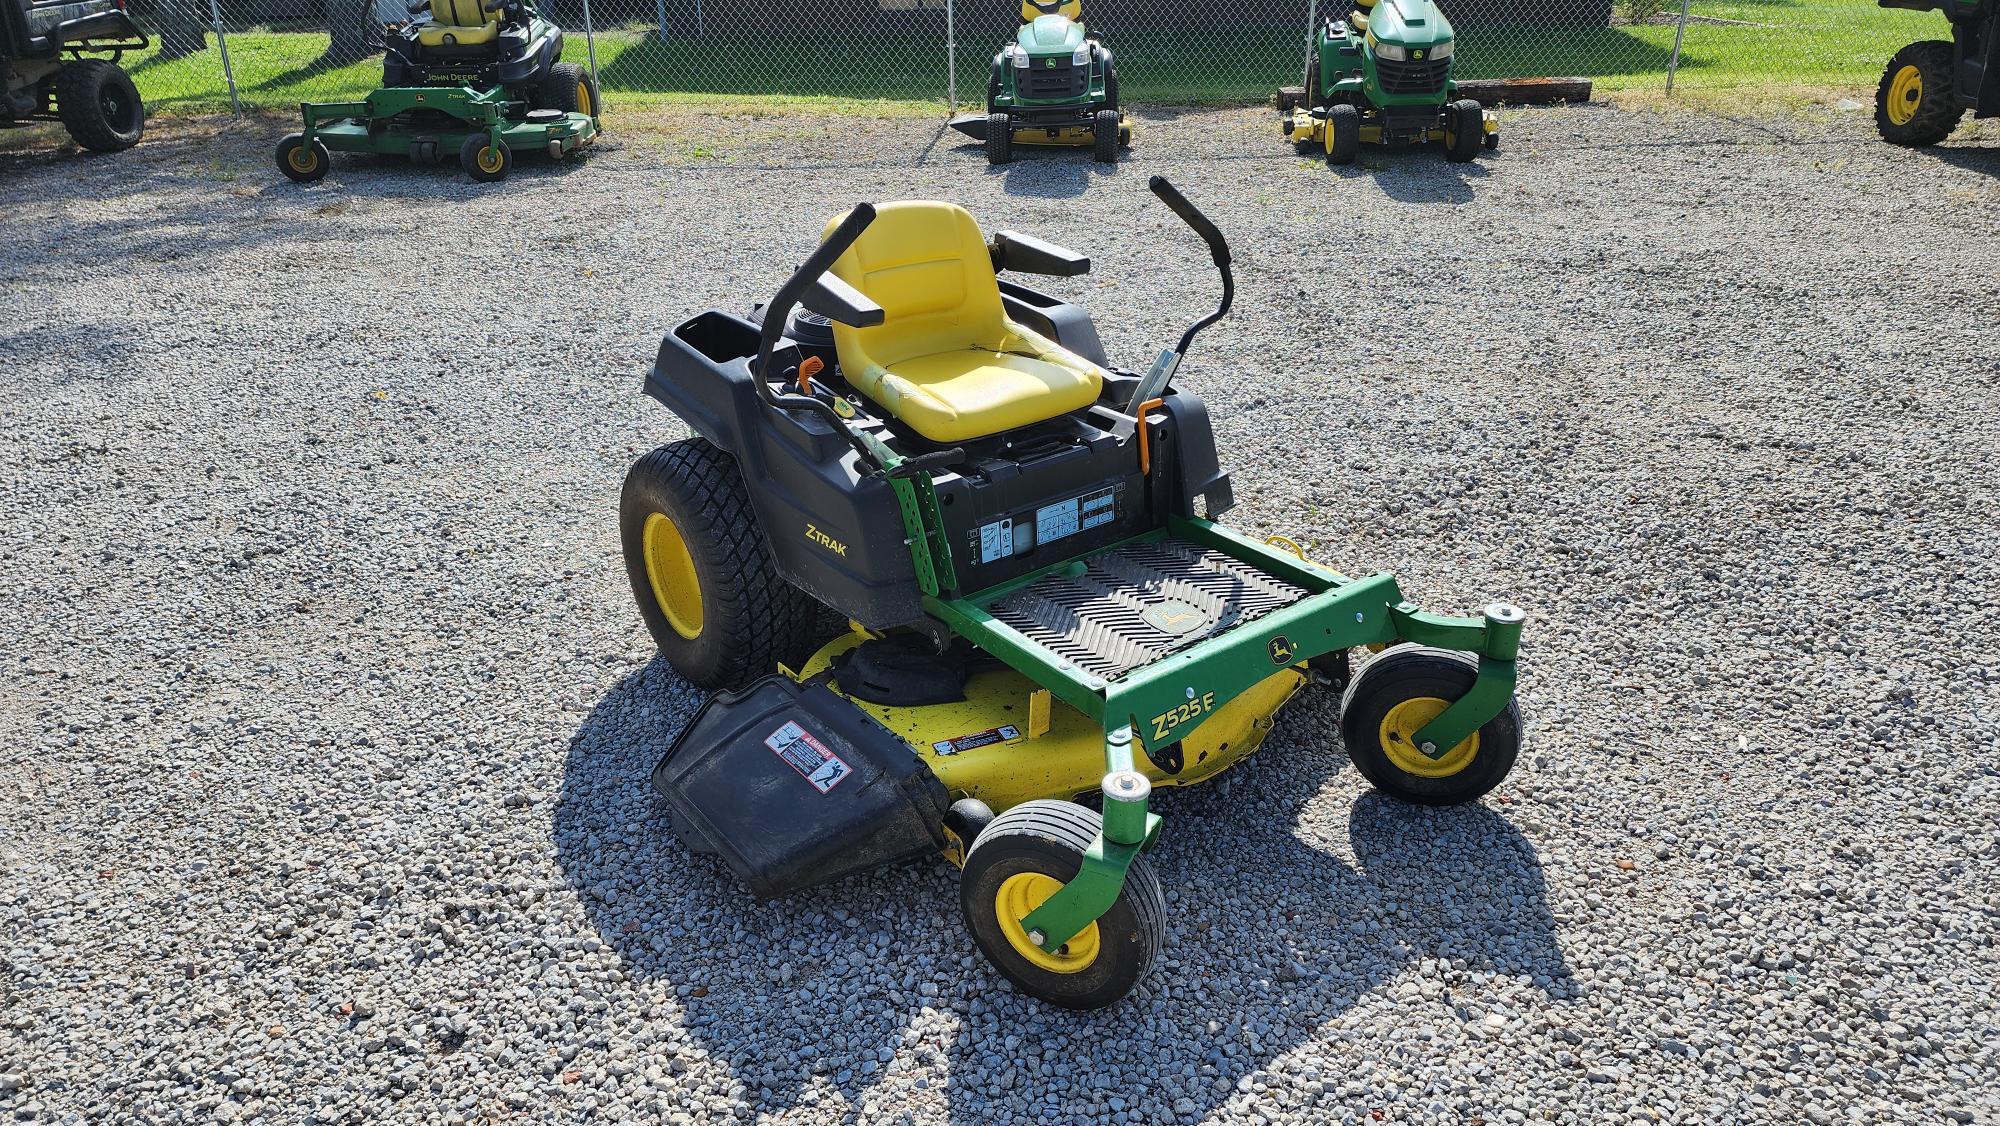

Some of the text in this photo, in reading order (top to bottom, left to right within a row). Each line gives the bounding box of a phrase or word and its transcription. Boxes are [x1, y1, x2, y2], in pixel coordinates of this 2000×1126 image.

[450, 73, 479, 81] DEERE
[805, 523, 847, 557] ZTRAK
[811, 739, 832, 758] DANGER
